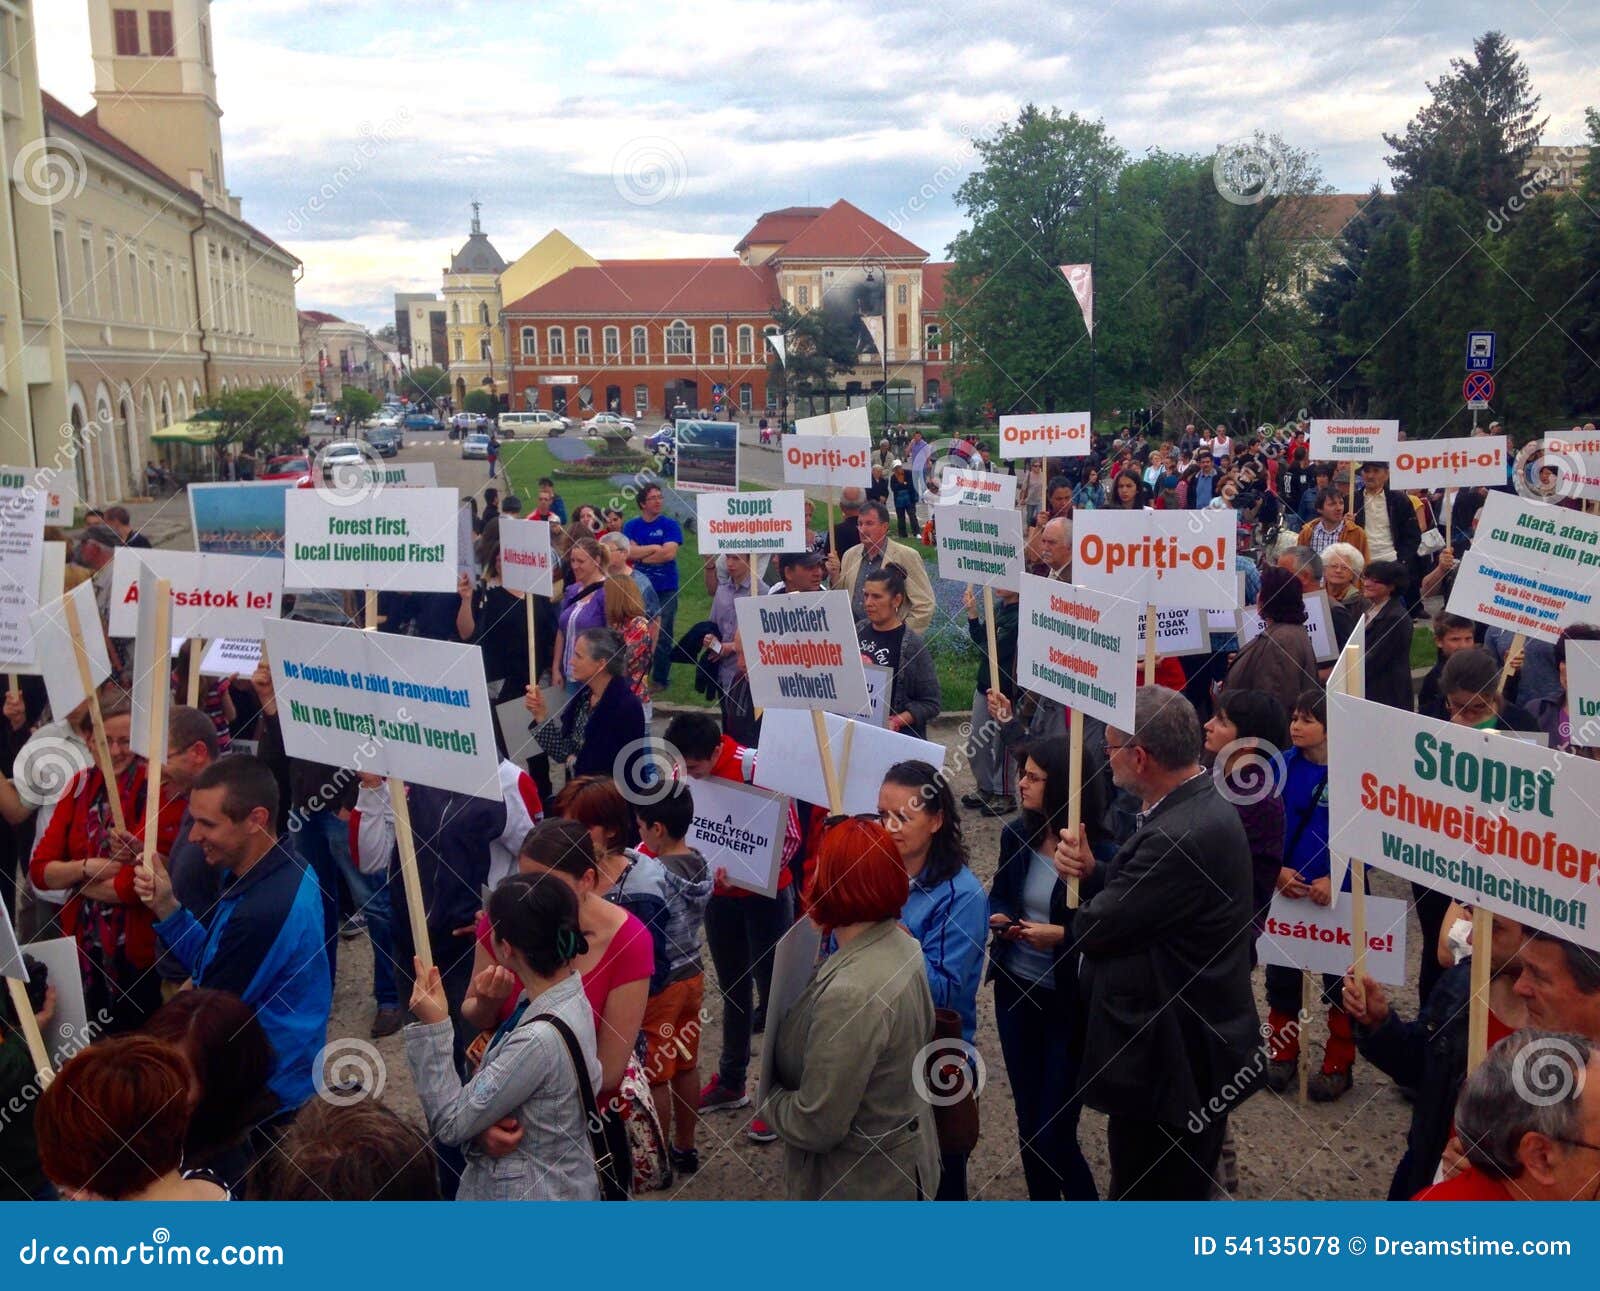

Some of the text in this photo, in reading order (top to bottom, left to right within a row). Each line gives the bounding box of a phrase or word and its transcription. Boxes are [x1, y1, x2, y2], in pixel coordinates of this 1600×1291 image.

[1473, 359, 1488, 368] TAXI
[1003, 423, 1086, 445] Opriți-o!
[1327, 425, 1380, 435] Schweighofer
[788, 447, 866, 472] Opriți-o!
[1396, 449, 1501, 474] Opriți-o!
[727, 498, 772, 516] Stoppt
[329, 517, 410, 537] Forest First,
[709, 519, 792, 534] Schweighofers
[1517, 513, 1599, 545] Afară, afară
[295, 543, 445, 562] Local Livelihood First!
[1080, 534, 1226, 580] Opriți-o!
[1491, 528, 1600, 567] cu mafia din țar
[123, 581, 273, 609] Ásátok le!
[1050, 594, 1101, 624] Schweighofer
[1493, 594, 1560, 621] Shame on you!
[759, 605, 830, 636] Boykottiert
[1158, 619, 1186, 629] CSAK
[1478, 603, 1517, 622] Schande
[1031, 609, 1121, 653] is destroying our forests!
[758, 639, 843, 669] Schweighofer
[1049, 646, 1099, 679] Schweighofer
[283, 660, 471, 708] Ne lopjátok el zöld aranyunkat!
[778, 672, 838, 700] weltweit!
[1032, 660, 1117, 709] is destroying our future!
[290, 700, 311, 723] Nu
[313, 705, 332, 728] ne
[378, 718, 422, 744] aurul
[423, 727, 478, 755] verde!
[1413, 731, 1555, 817] Stoppt
[693, 816, 768, 848] ZÉKELYFÖLDI
[724, 814, 732, 825] A
[1382, 831, 1587, 930] Waldschlachthof!
[1264, 917, 1351, 946] tsátok
